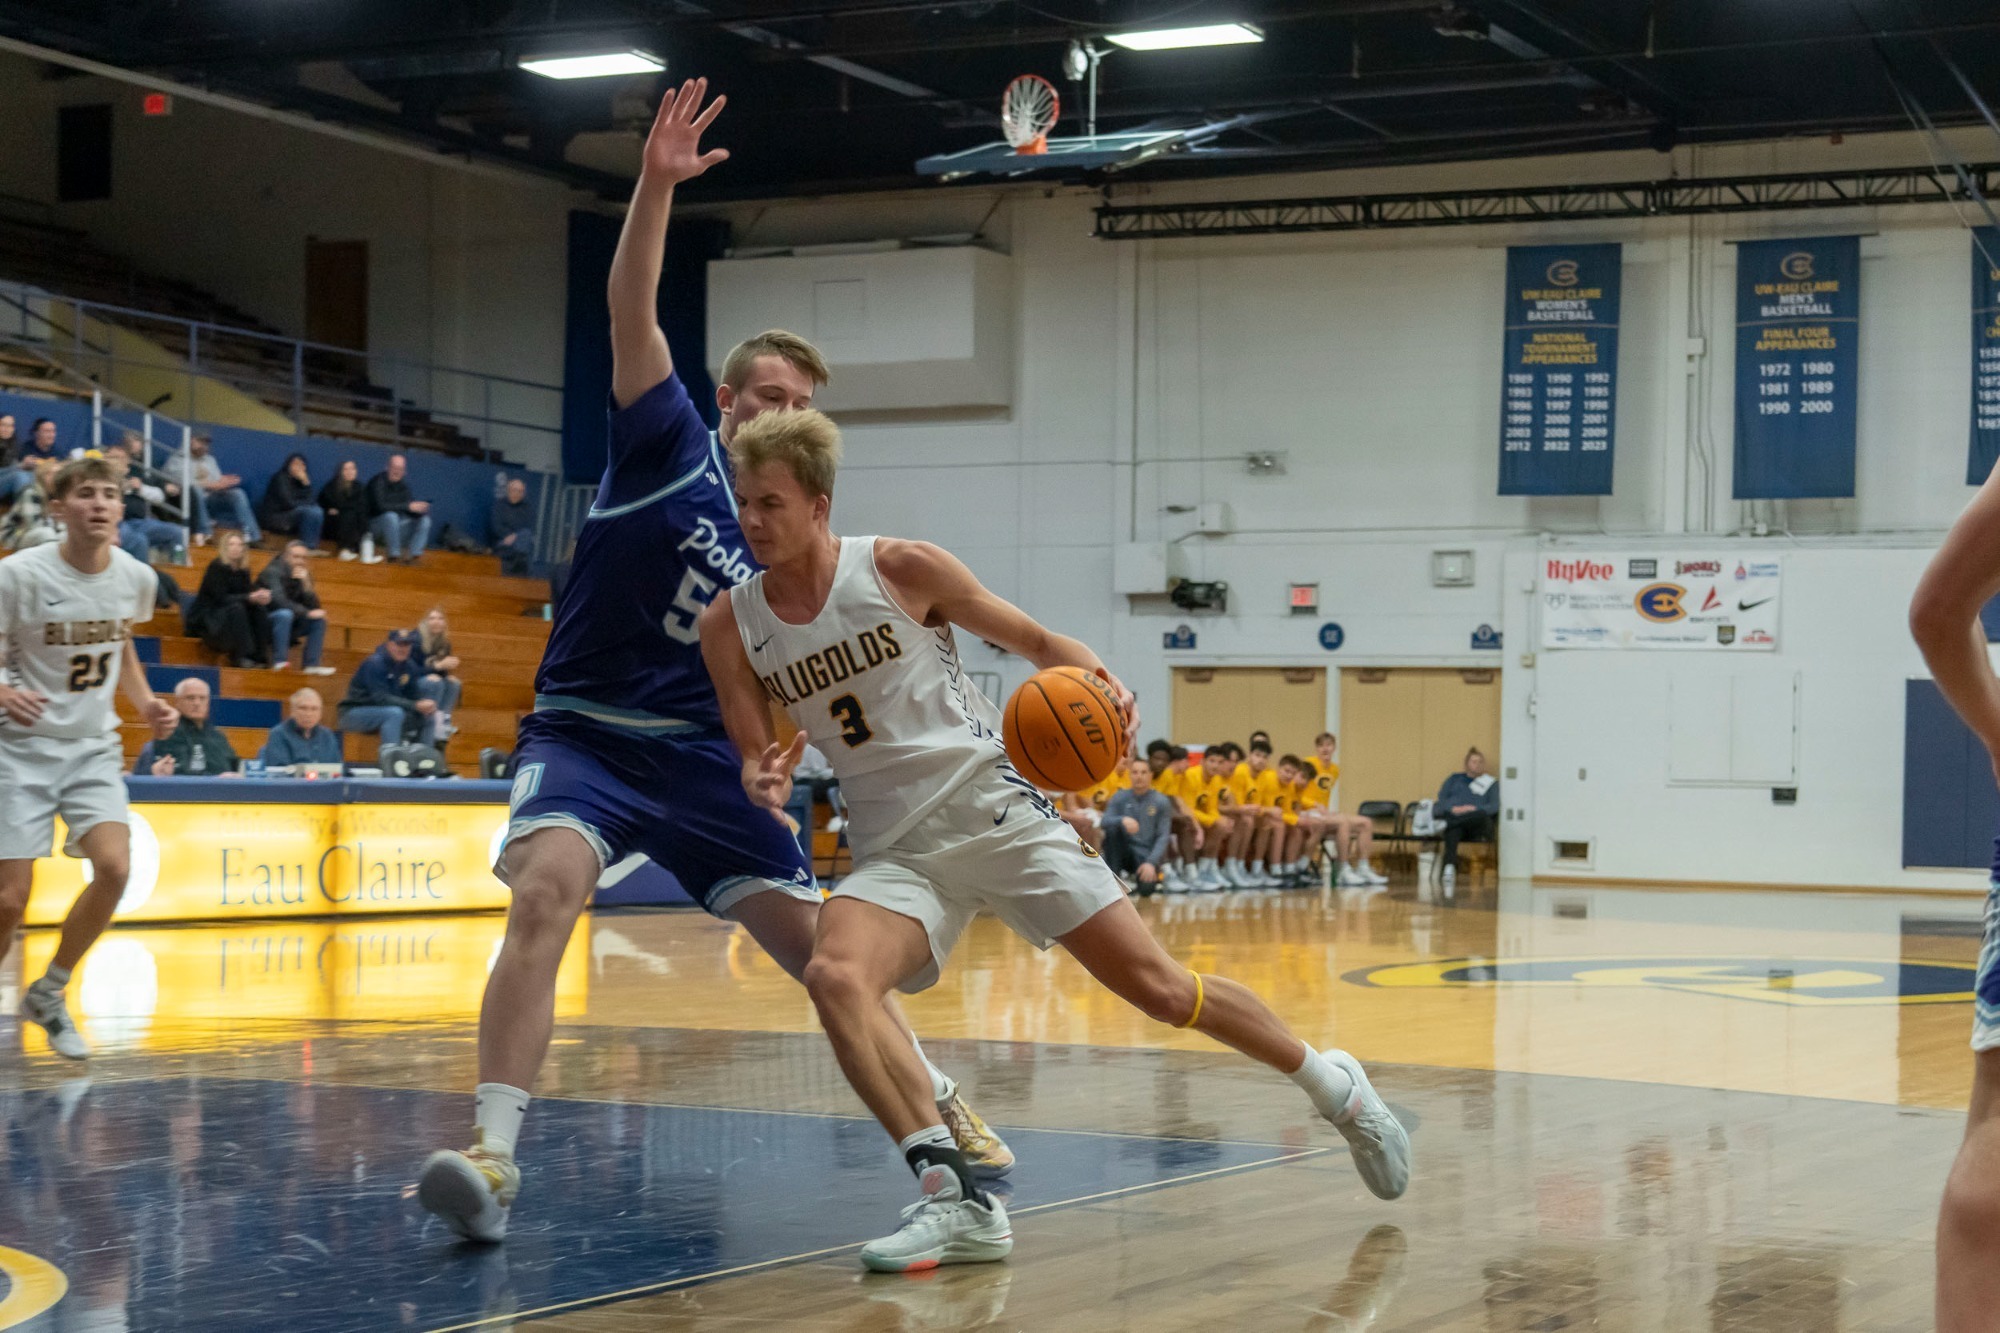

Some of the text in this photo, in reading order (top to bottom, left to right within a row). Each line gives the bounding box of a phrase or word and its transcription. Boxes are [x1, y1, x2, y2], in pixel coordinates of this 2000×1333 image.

[1535, 300, 1588, 310] WOMEN'S
[1779, 293, 1815, 304] MEN'S
[1527, 310, 1595, 321] BASKETBALL
[1761, 303, 1833, 317] BASKETBALL
[1763, 326, 1830, 340] FINAL FOUR
[1755, 337, 1837, 350] APPEARANCES
[1759, 361, 1835, 377] 1972 1980
[1759, 380, 1834, 396] 1981 1989
[1758, 400, 1834, 415] 1990 2000
[677, 516, 756, 584] Pola
[662, 565, 718, 645] 5
[828, 691, 875, 751] 3
[1068, 701, 1106, 745] EVO
[219, 841, 447, 906] Eau Claire
